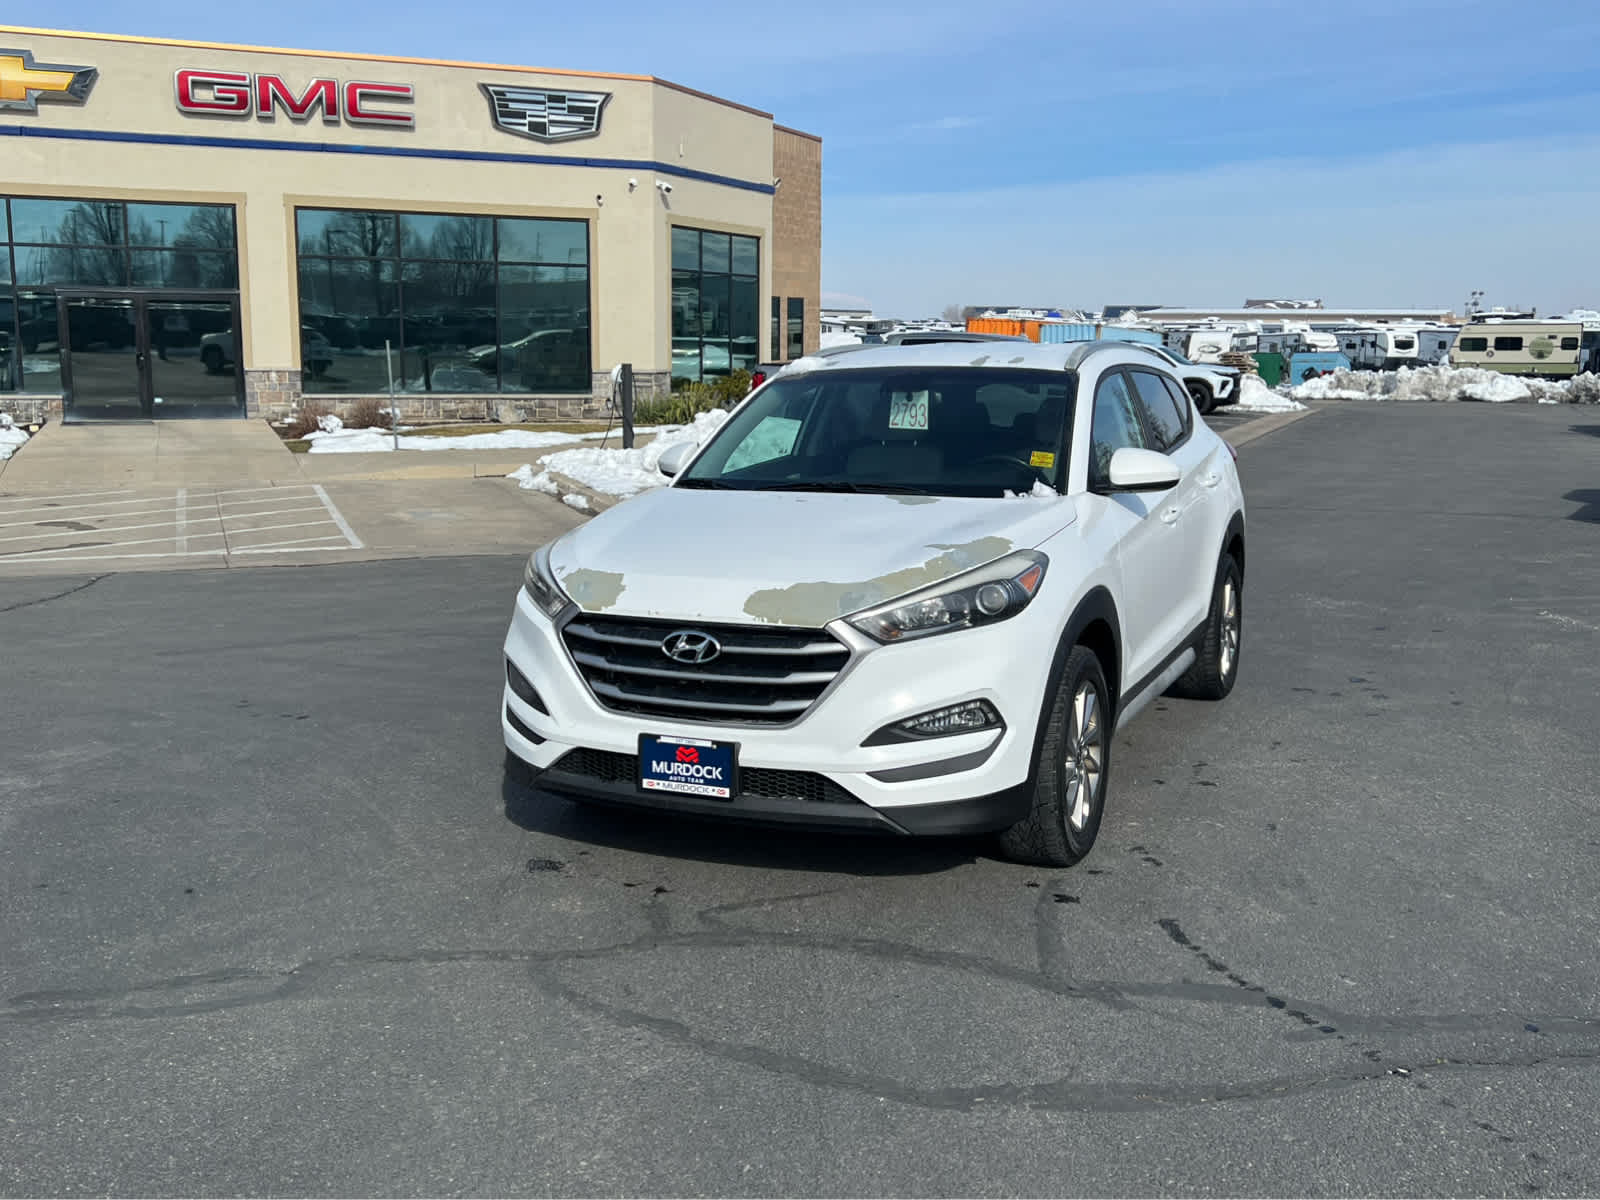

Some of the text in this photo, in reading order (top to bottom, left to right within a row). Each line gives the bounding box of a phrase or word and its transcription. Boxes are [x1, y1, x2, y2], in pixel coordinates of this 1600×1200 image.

[174, 68, 415, 127] GMC
[891, 403, 927, 427] 2793
[652, 760, 722, 780] MURDOCK
[662, 782, 710, 793] MURDOCK
